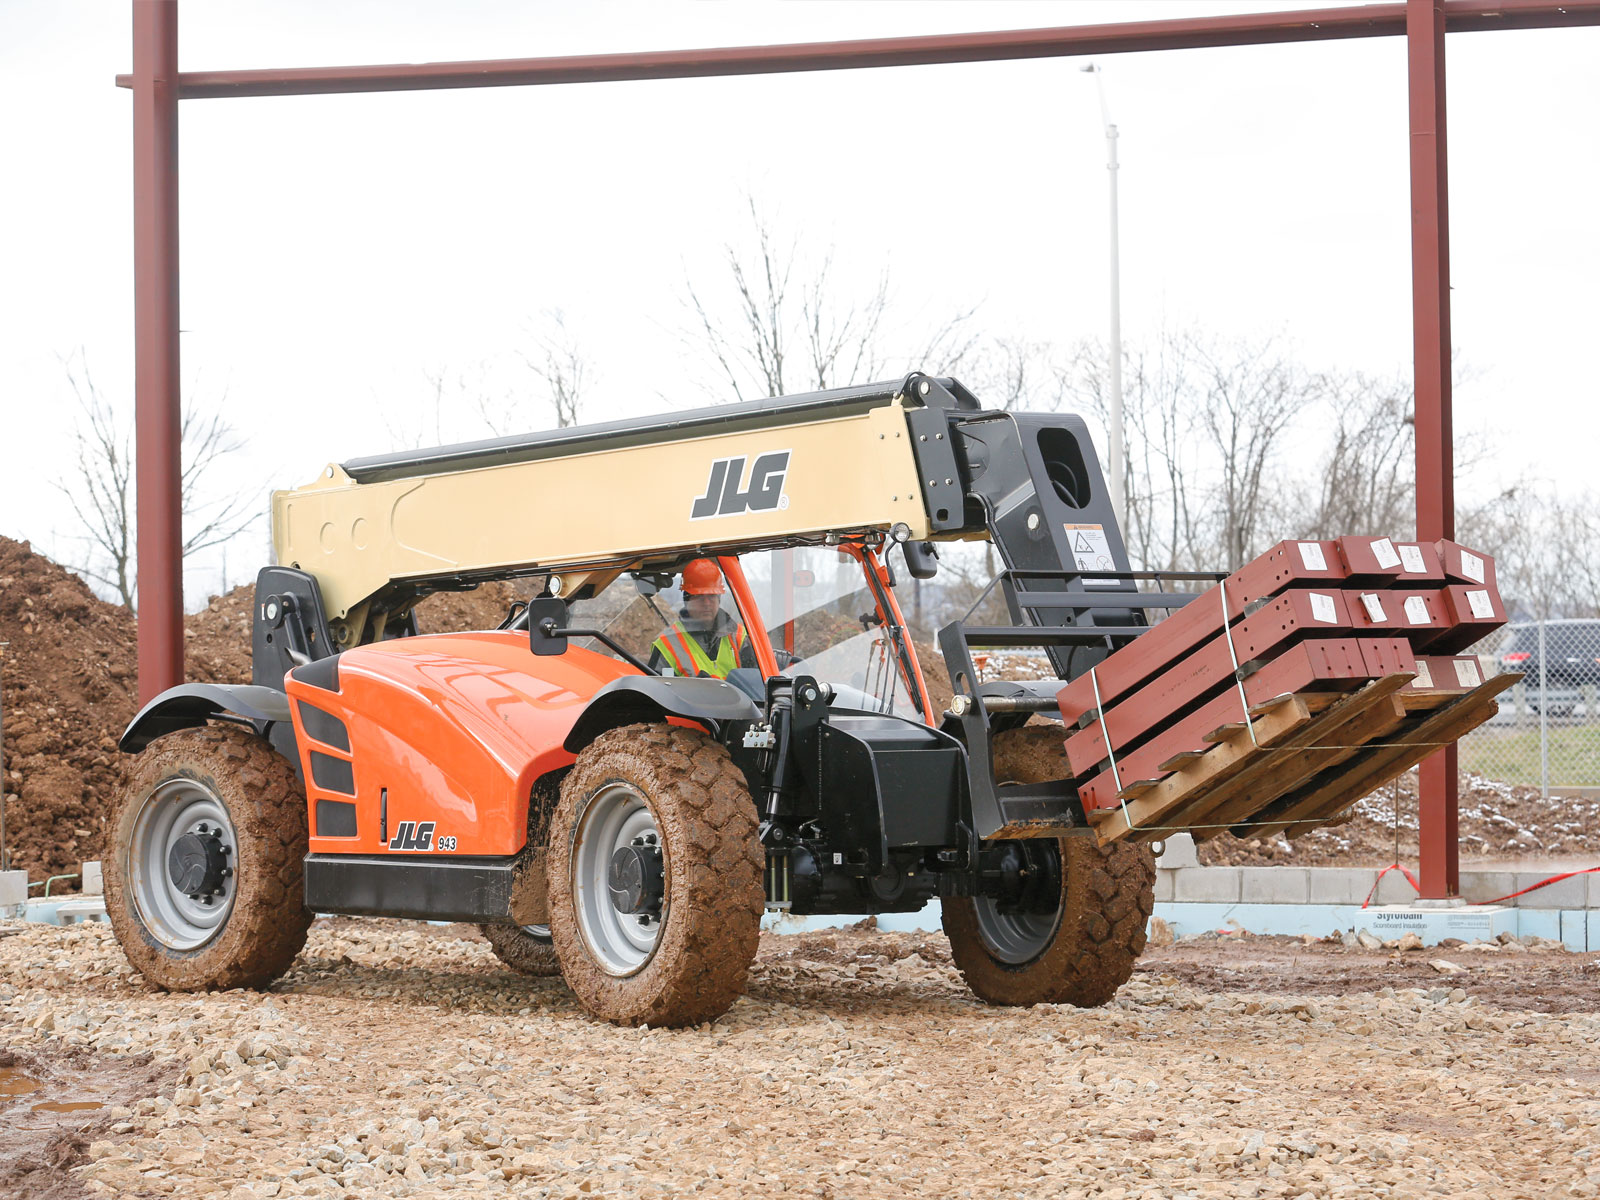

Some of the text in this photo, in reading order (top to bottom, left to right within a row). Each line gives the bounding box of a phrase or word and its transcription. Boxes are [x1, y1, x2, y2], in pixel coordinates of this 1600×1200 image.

[690, 450, 791, 520] JLG
[389, 822, 456, 850] JLG 943
